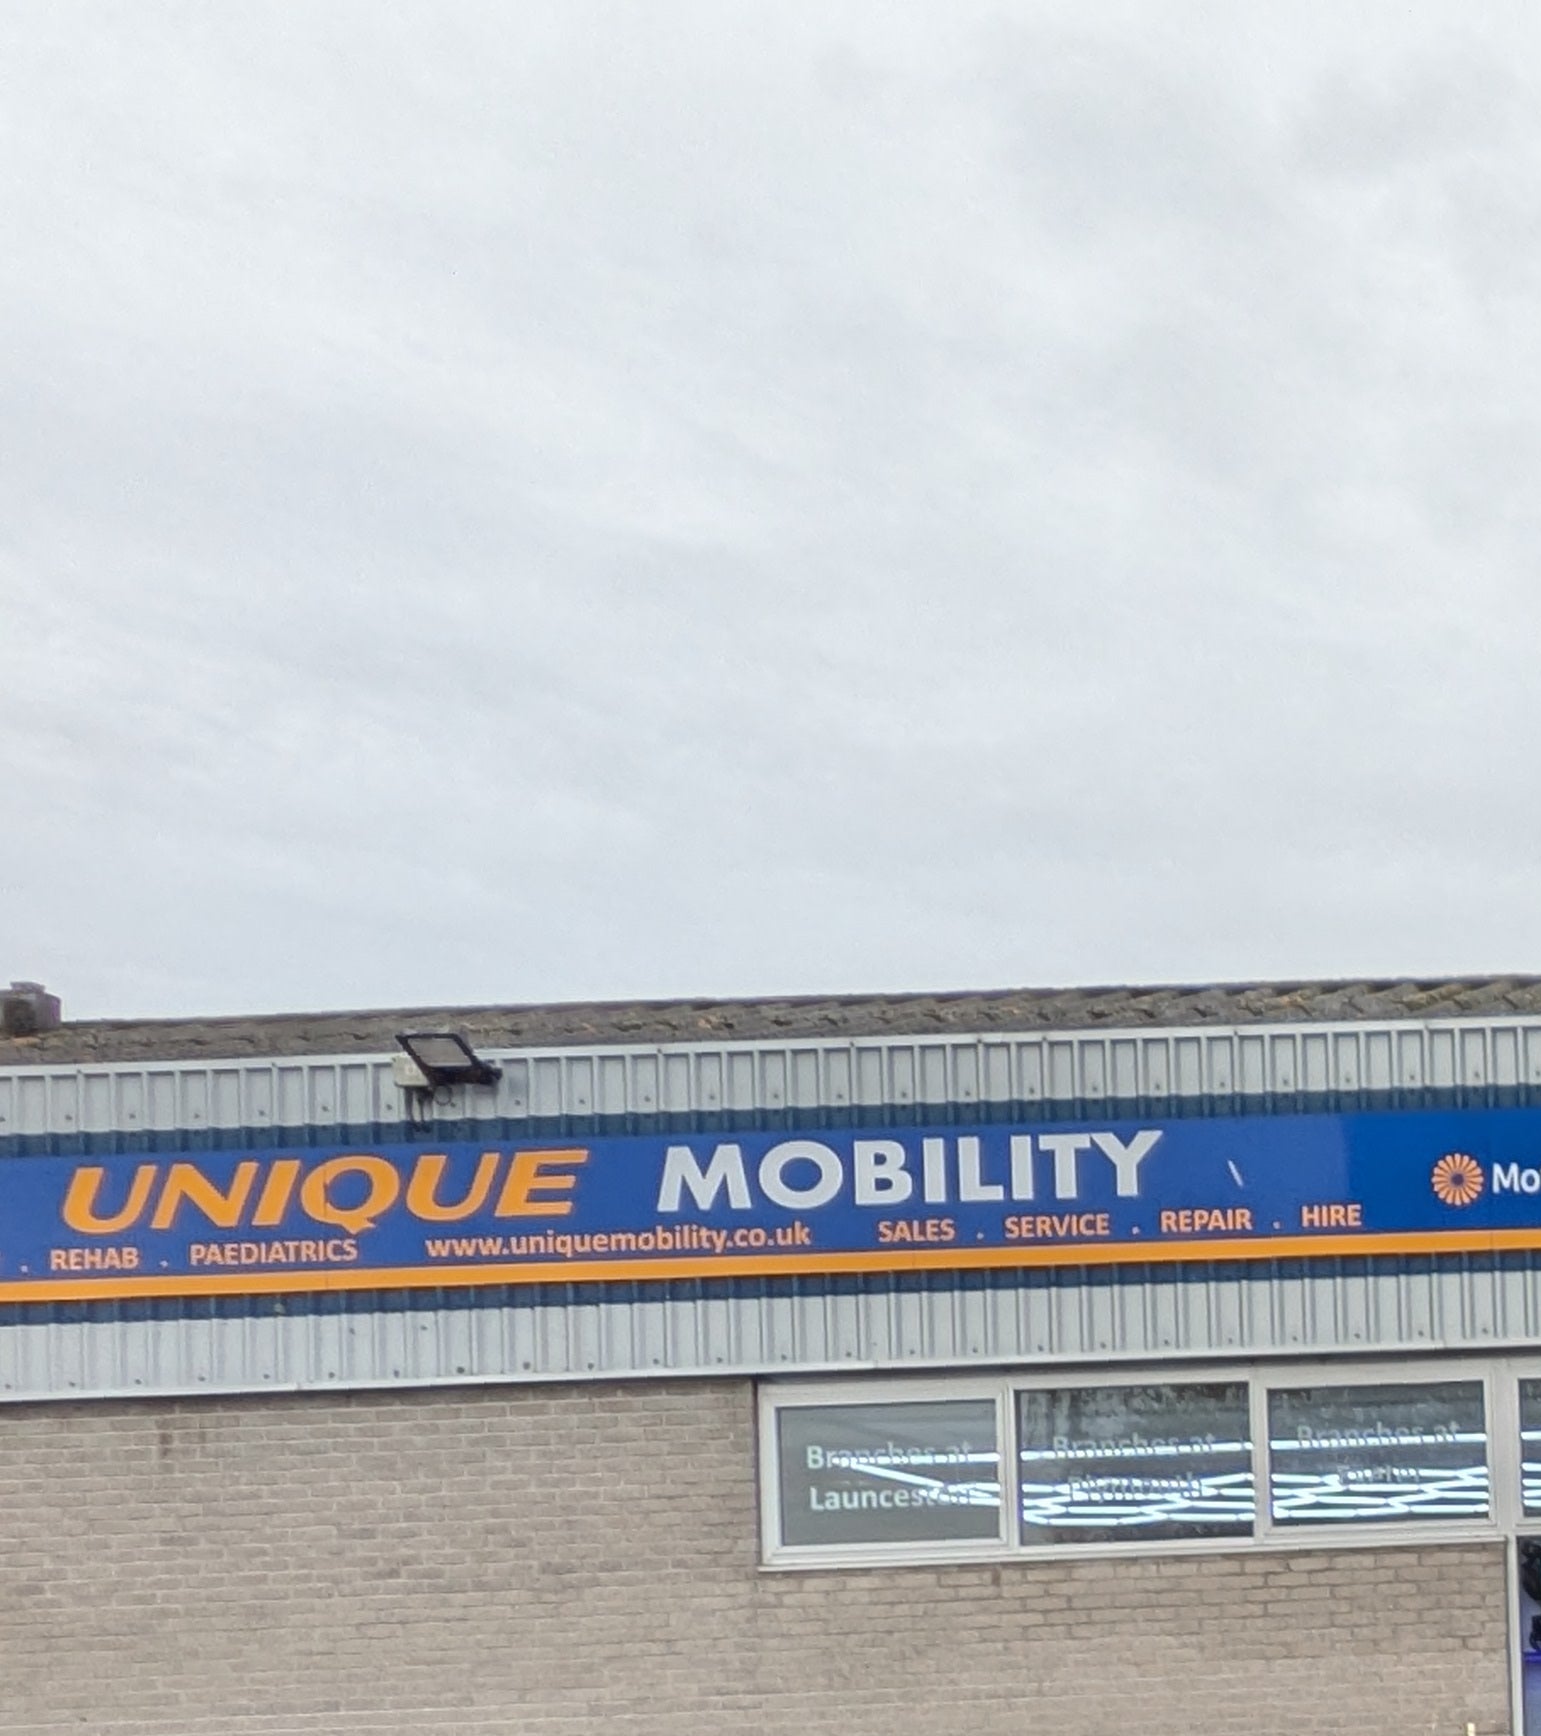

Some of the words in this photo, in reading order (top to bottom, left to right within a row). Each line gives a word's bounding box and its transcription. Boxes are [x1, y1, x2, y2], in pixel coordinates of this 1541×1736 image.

[61, 1149, 590, 1235] UNIQUE
[656, 1130, 1164, 1212] MOBILITY
[425, 1220, 811, 1260] www.uniquemobility.co.uk
[878, 1219, 955, 1243] SALES
[1005, 1213, 1110, 1240] SERVICE
[1160, 1207, 1252, 1233] REPAIR
[1301, 1204, 1362, 1229] HIRE
[50, 1245, 139, 1272] REHAB
[189, 1238, 358, 1265] PAEDIATRICS
